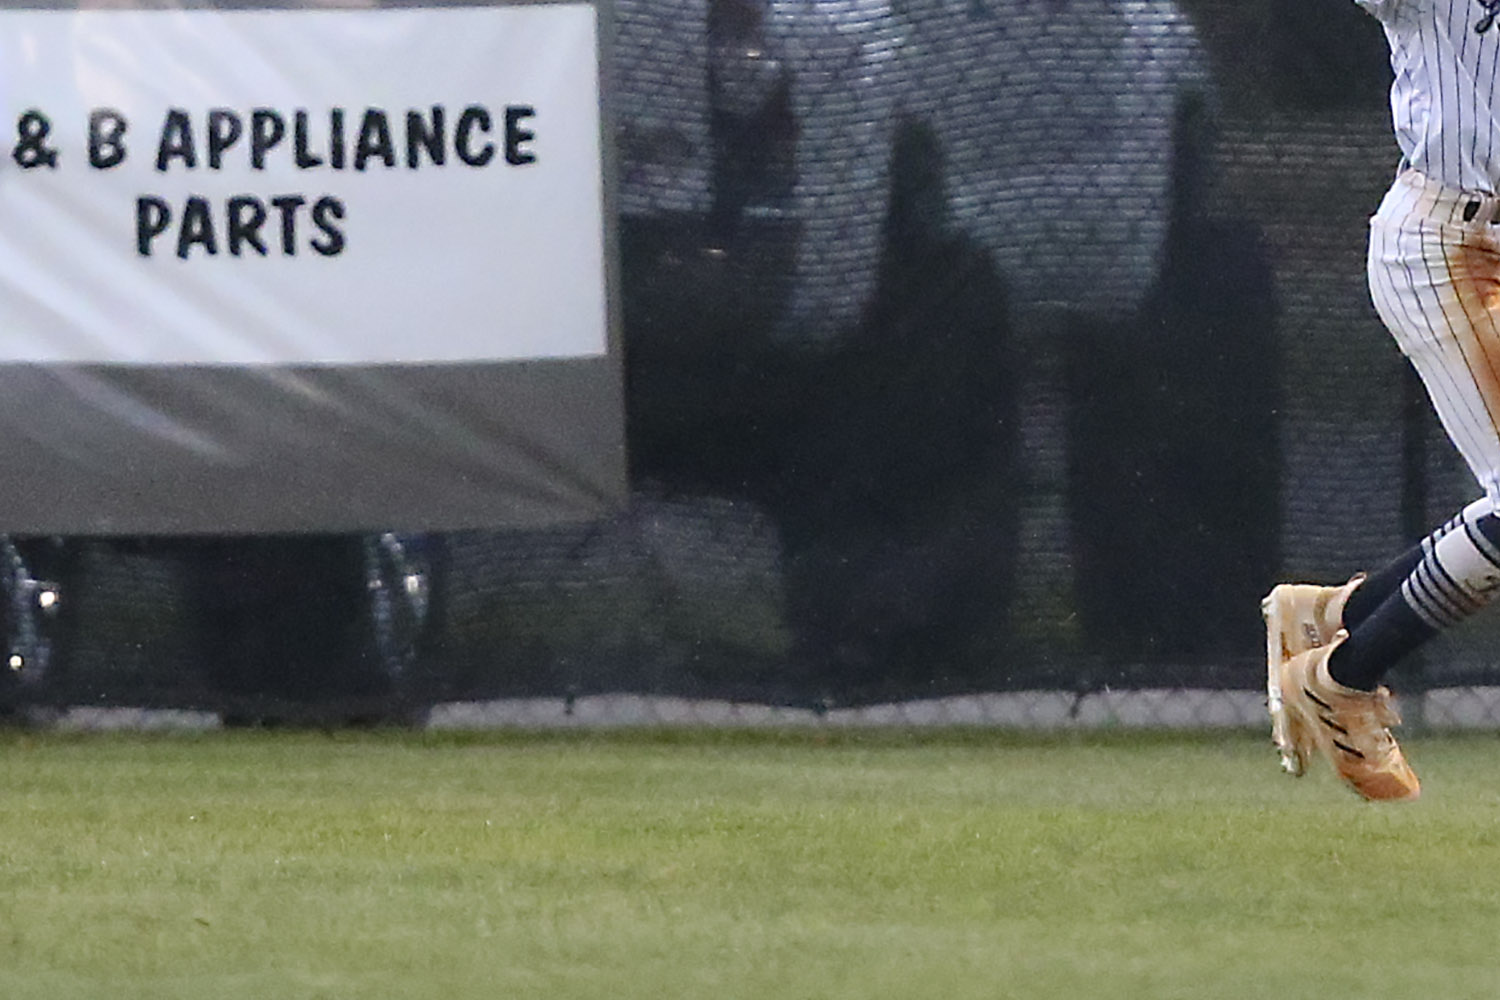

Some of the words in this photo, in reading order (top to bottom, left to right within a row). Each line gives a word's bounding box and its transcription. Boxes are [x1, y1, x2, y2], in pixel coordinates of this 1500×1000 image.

[12, 109, 58, 169] &
[88, 108, 128, 169] B
[155, 105, 538, 172] APPLIANCE
[136, 195, 347, 259] PARTS
